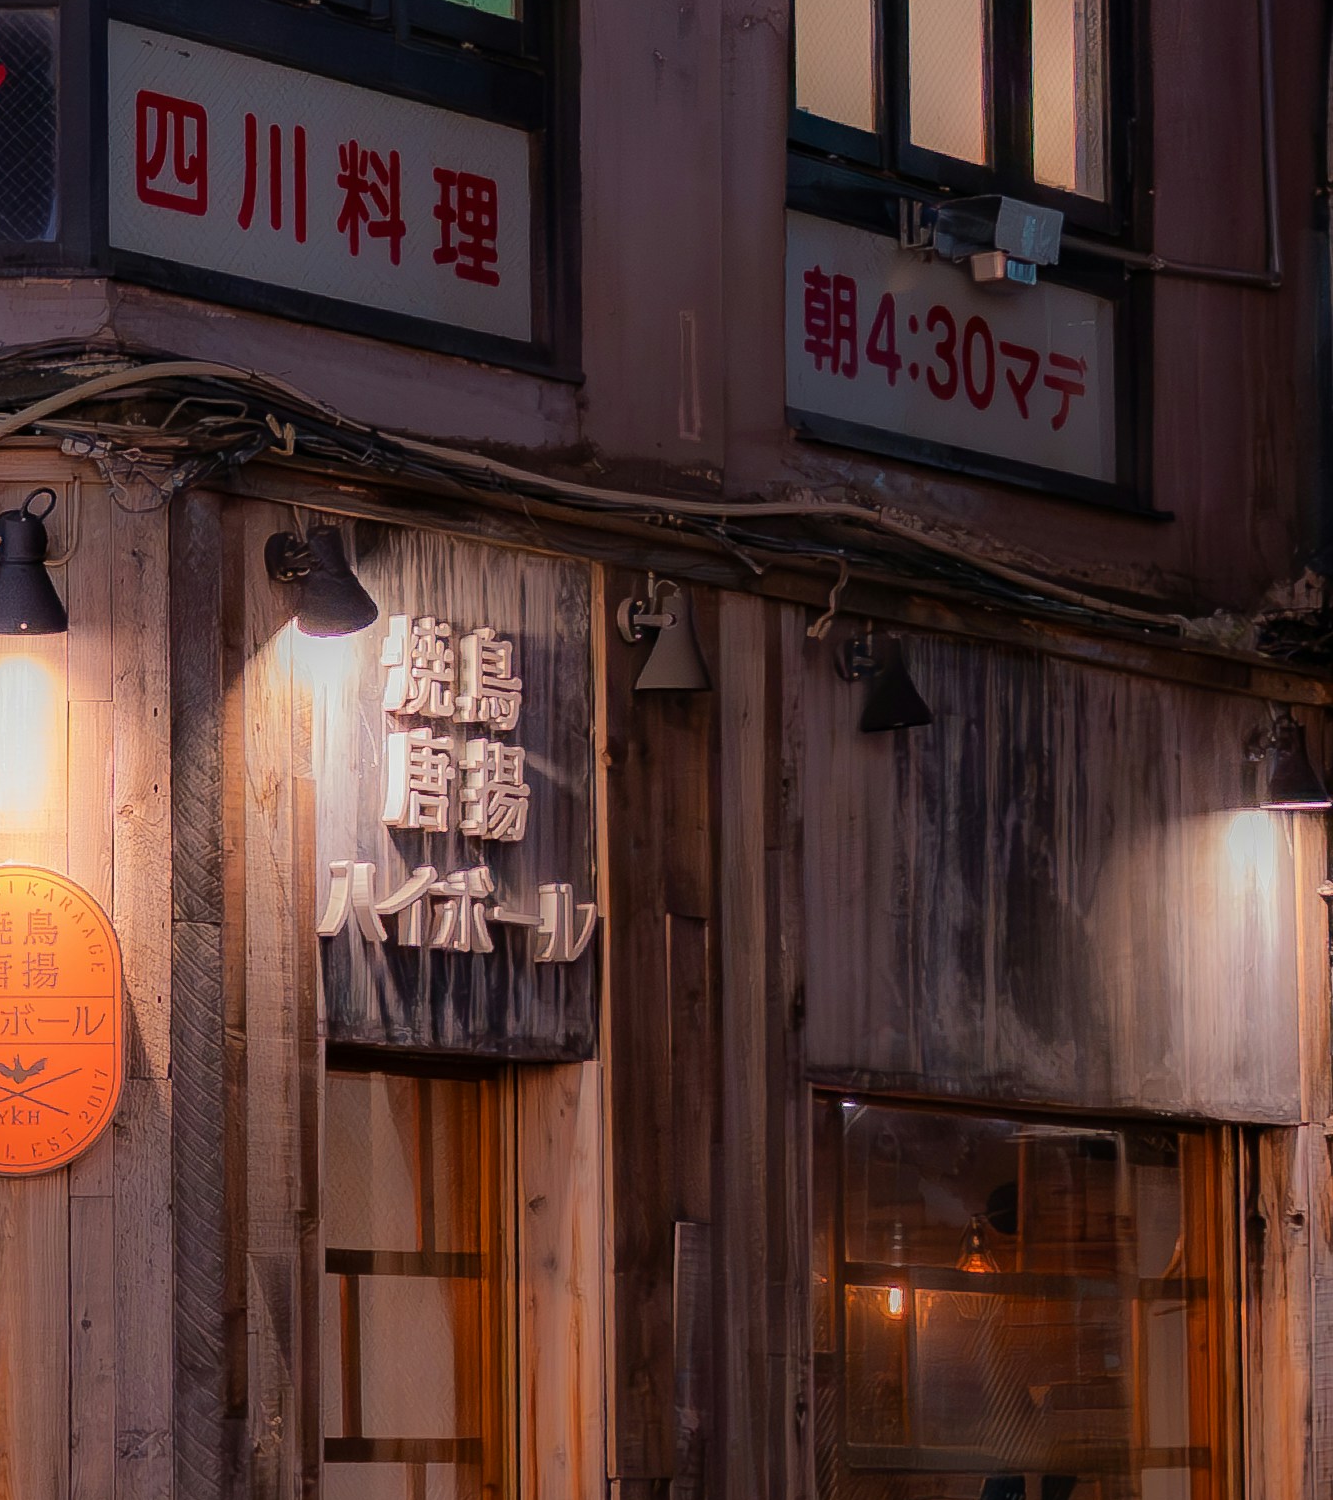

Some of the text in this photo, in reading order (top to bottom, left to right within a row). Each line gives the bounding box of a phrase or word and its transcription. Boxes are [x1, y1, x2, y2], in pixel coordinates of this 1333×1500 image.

[135, 86, 502, 288] 四川料理
[801, 262, 1089, 433] 朝4:30マデ
[381, 613, 523, 732] 焼鳥
[381, 726, 531, 842] 唐揚
[317, 859, 598, 963] ハイボール
